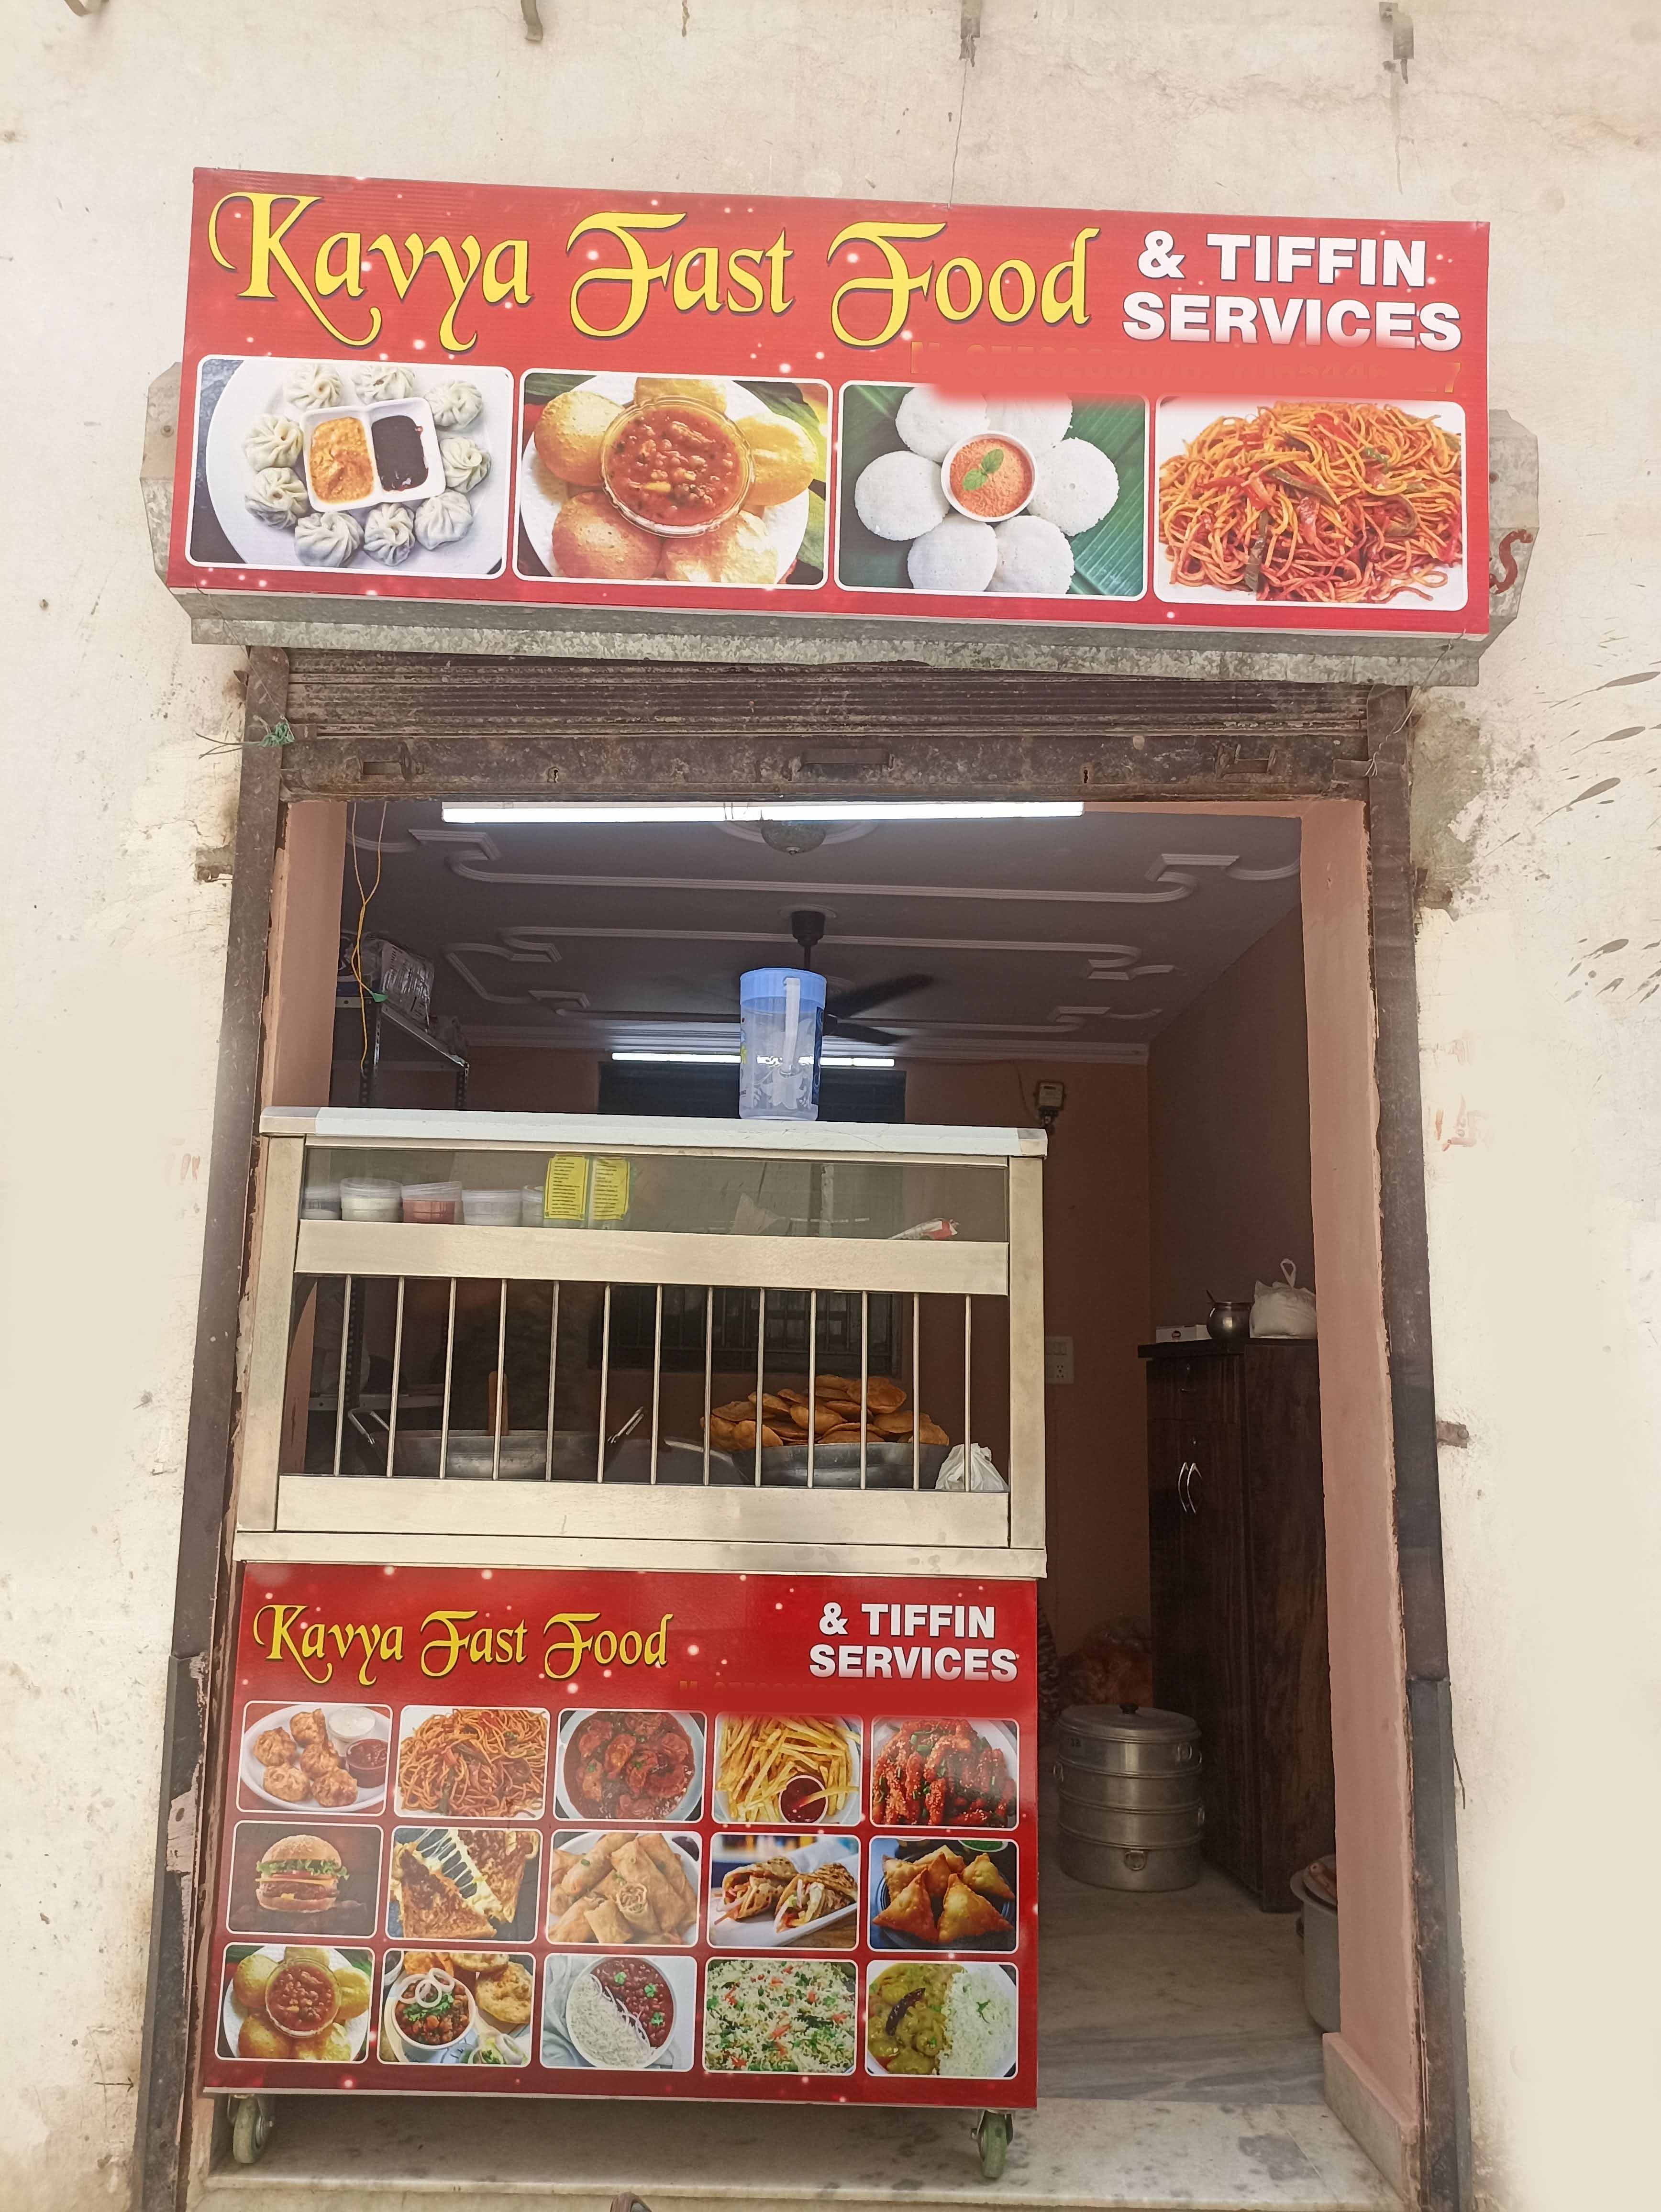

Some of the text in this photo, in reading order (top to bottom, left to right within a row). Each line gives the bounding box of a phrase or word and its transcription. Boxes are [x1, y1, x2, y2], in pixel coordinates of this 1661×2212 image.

[208, 190, 1099, 352] Kavya Fast Food
[1137, 230, 1426, 287] & TIFFIN
[1122, 291, 1462, 352] SERVICES
[253, 1604, 674, 1686] Kavya Fast Food
[819, 1602, 995, 1639] & TIFFIN
[808, 1643, 1018, 1682] SERVICES
